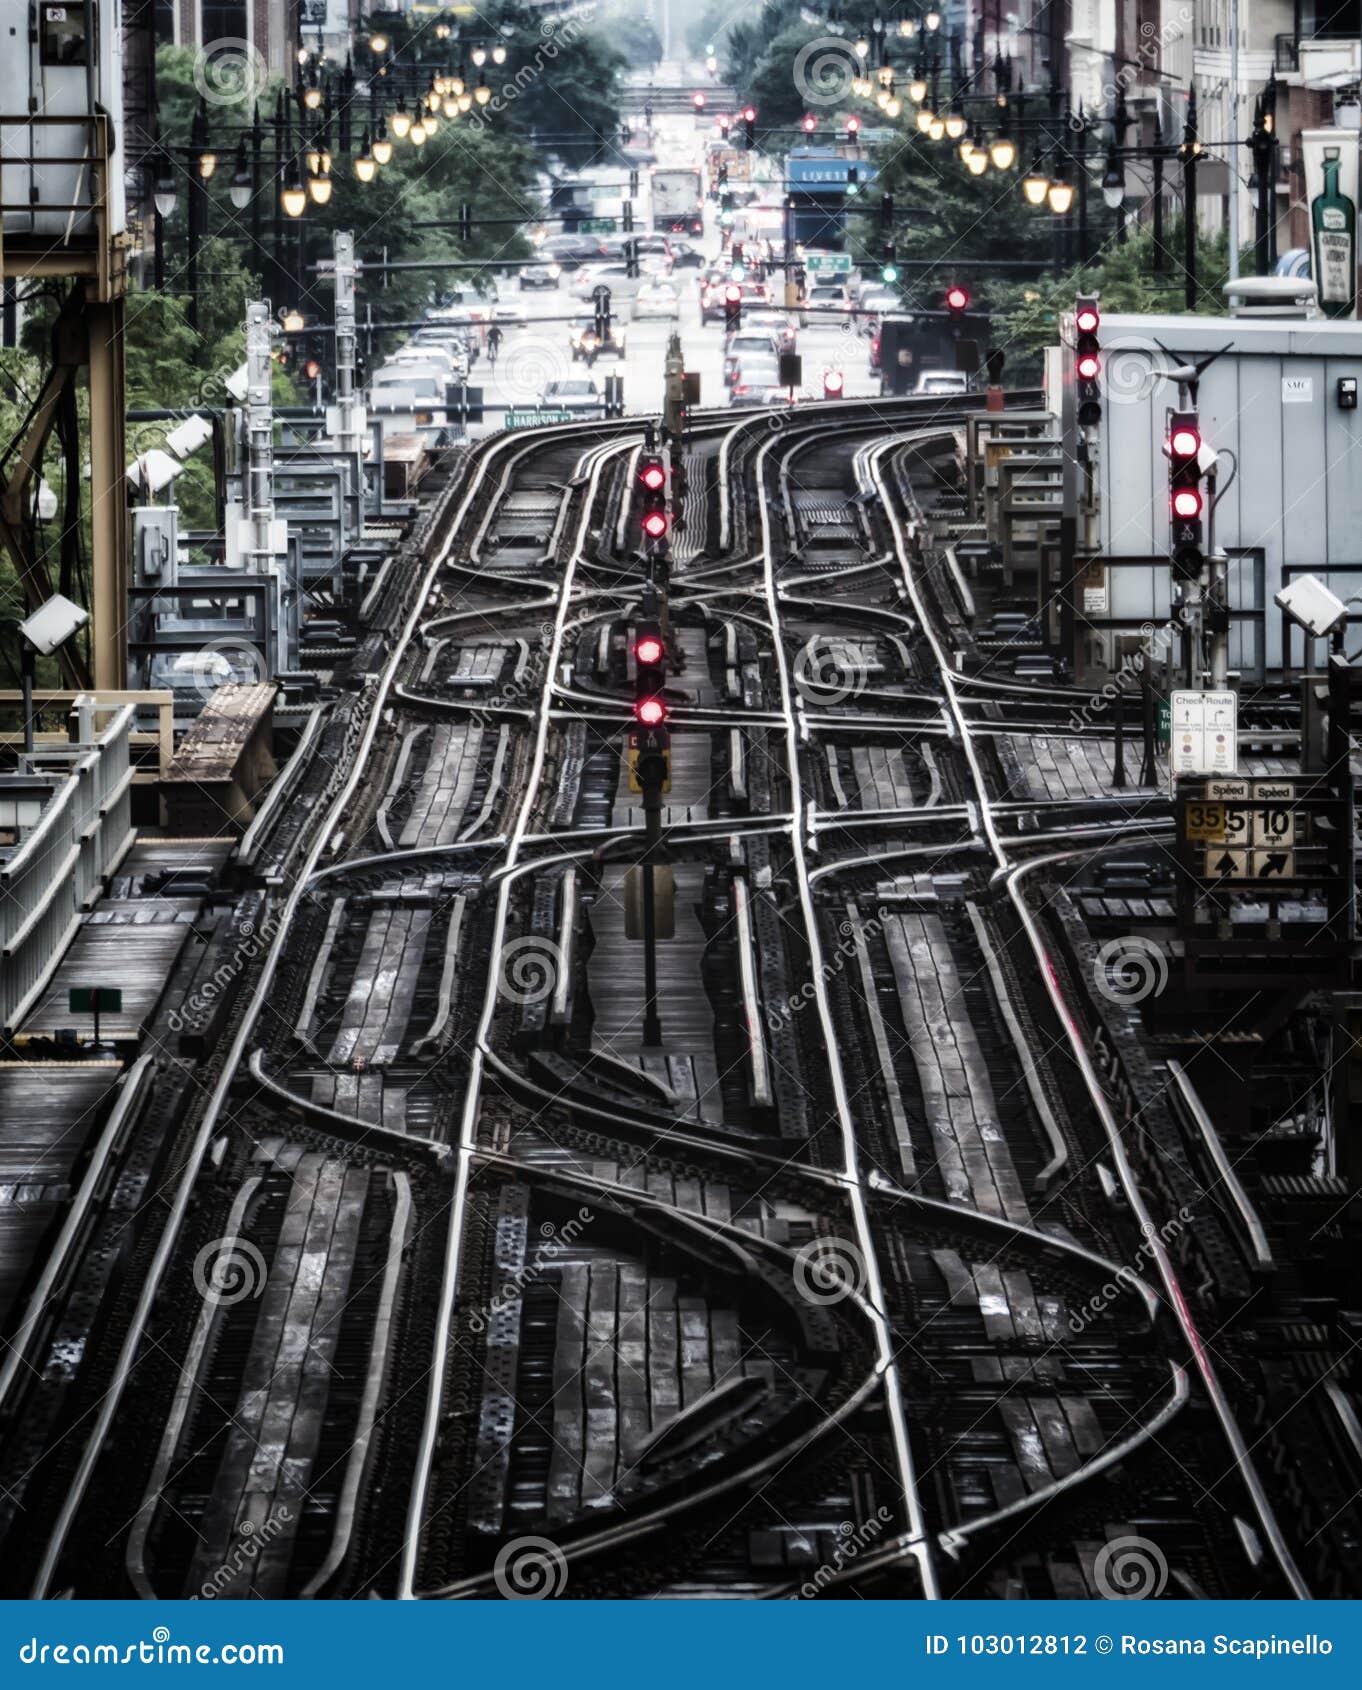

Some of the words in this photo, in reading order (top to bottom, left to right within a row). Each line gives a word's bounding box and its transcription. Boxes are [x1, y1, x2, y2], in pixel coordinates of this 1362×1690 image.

[513, 414, 559, 427] HARRISON
[1181, 532, 1195, 541] 20
[1176, 696, 1203, 705] Check
[1206, 696, 1233, 705] Route
[1212, 784, 1244, 799] Speed
[1258, 786, 1290, 799] Speed
[1190, 807, 1220, 829] 35
[1258, 810, 1290, 835] 10
[1265, 835, 1282, 845] mph
